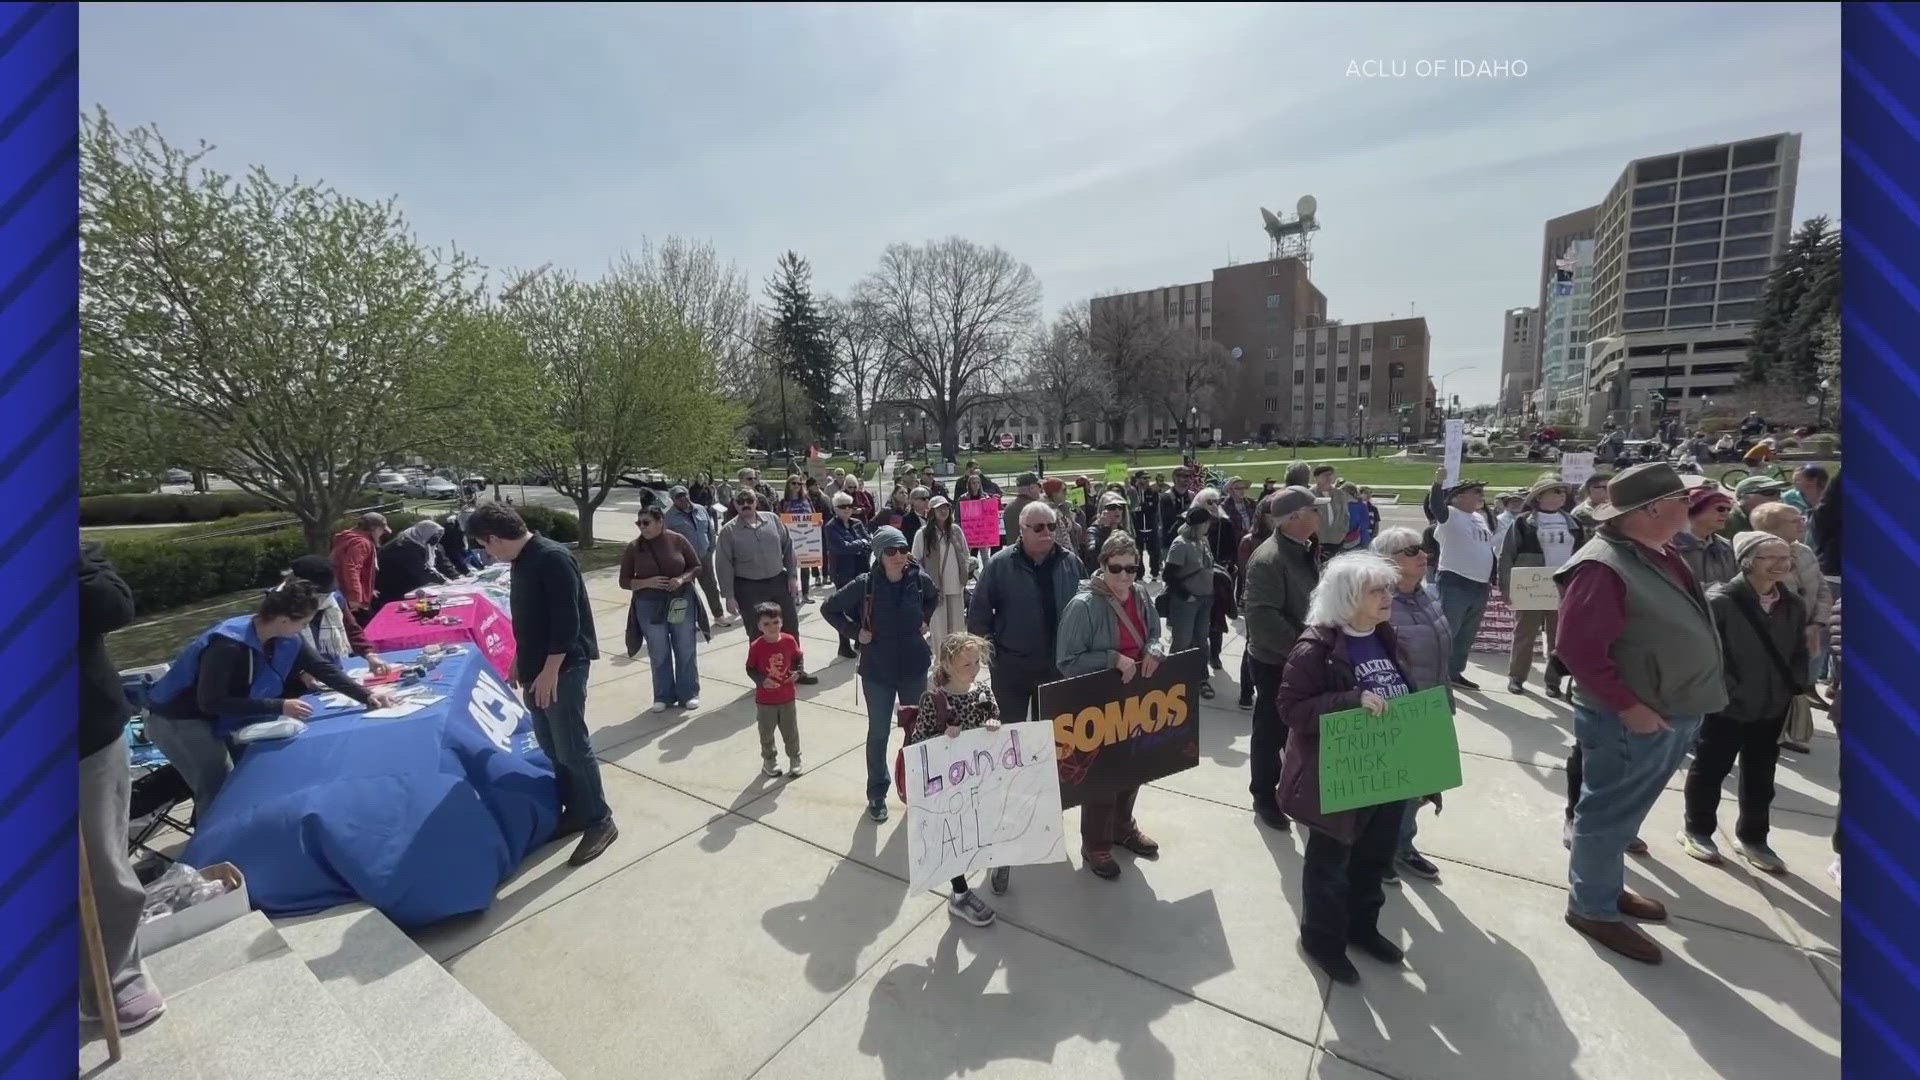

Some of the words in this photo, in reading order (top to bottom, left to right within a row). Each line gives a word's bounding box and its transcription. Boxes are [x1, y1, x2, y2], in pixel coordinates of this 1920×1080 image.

[1052, 683, 1188, 760] SOMOS
[1325, 717, 1348, 736] NO
[1334, 728, 1402, 754] TRUMP
[920, 729, 1024, 798] Land
[1335, 752, 1388, 775] MUSK
[1333, 769, 1412, 800] HITLER
[948, 785, 979, 815] OF
[940, 808, 993, 865] ALL
